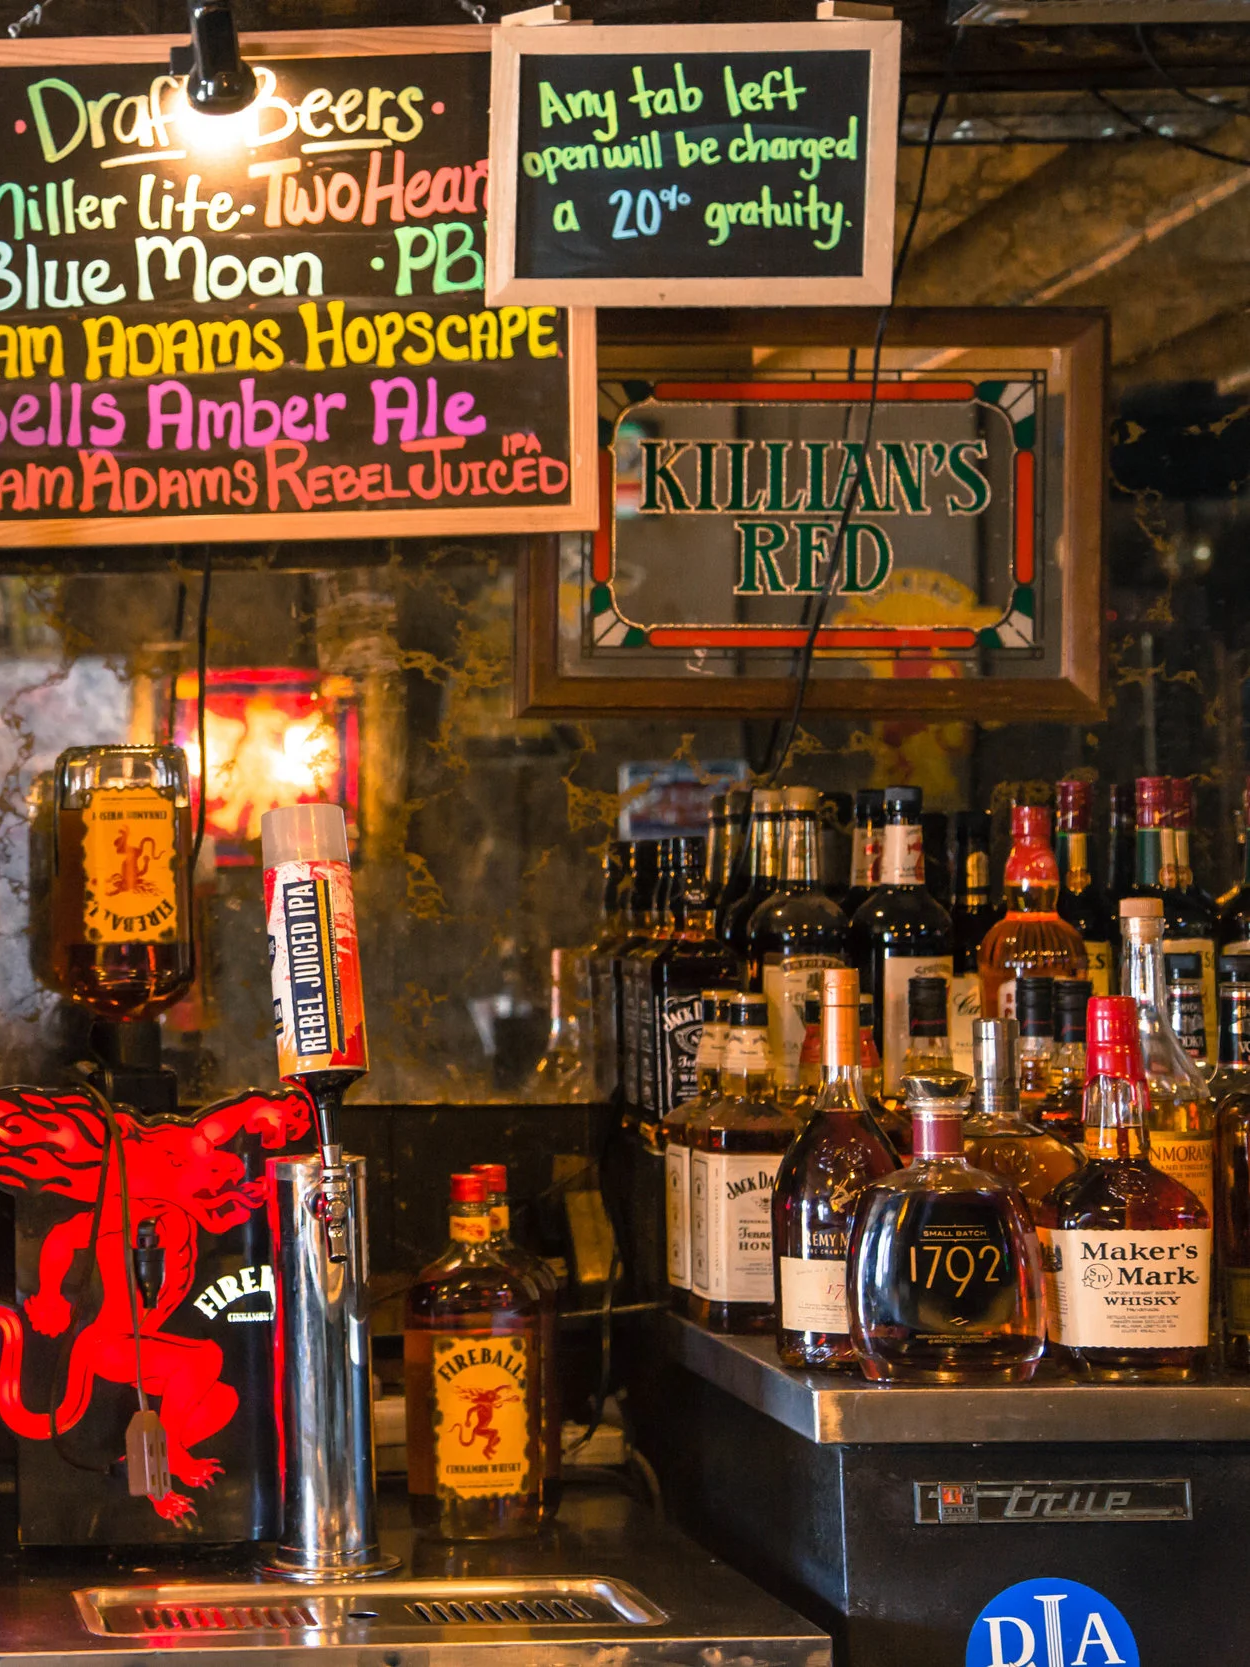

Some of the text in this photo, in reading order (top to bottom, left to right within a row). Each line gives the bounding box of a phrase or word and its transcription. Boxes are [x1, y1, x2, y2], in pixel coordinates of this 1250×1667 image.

[27, 66, 424, 163] Draf Beers
[539, 63, 807, 142] Any tab left
[675, 131, 721, 167] be
[728, 116, 858, 181] charged
[553, 184, 852, 251] a 20% gratuity.
[135, 235, 323, 302] Moon
[394, 222, 488, 296] PB
[147, 378, 348, 451] Amber
[372, 377, 487, 445] Ale
[503, 434, 542, 456] IPA
[638, 438, 992, 517] KILLIAN'S
[733, 520, 894, 596] RED
[288, 880, 316, 918] IPA
[290, 921, 323, 988] JUICED
[297, 991, 328, 1053] REBEL
[726, 1176, 757, 1200] JACK
[910, 1245, 1001, 1298] 1792
[1080, 1241, 1199, 1261] Maker's
[1116, 1266, 1199, 1286] Mark
[1103, 1296, 1182, 1306] WHISKY
[437, 1347, 524, 1383] FIREBALL
